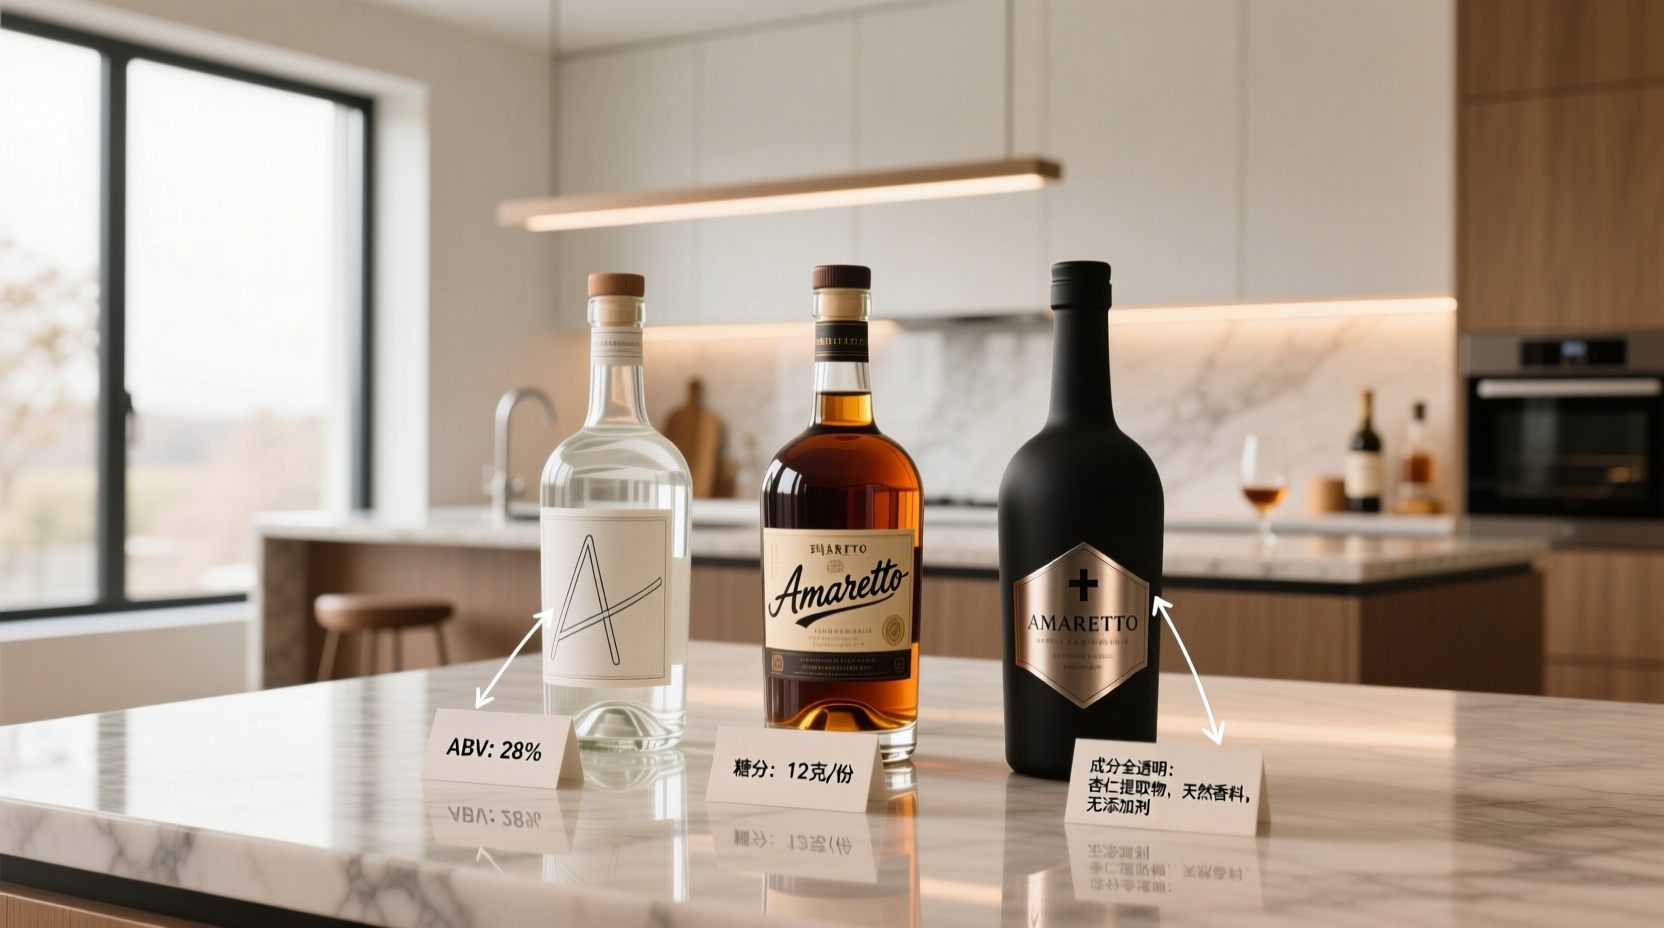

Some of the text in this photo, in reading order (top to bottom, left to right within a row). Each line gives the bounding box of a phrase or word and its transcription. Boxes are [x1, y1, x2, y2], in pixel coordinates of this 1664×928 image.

[768, 558, 909, 618] Amaretto
[1028, 614, 1138, 632] AMARETTO
[446, 737, 542, 762] ABV: 28%
